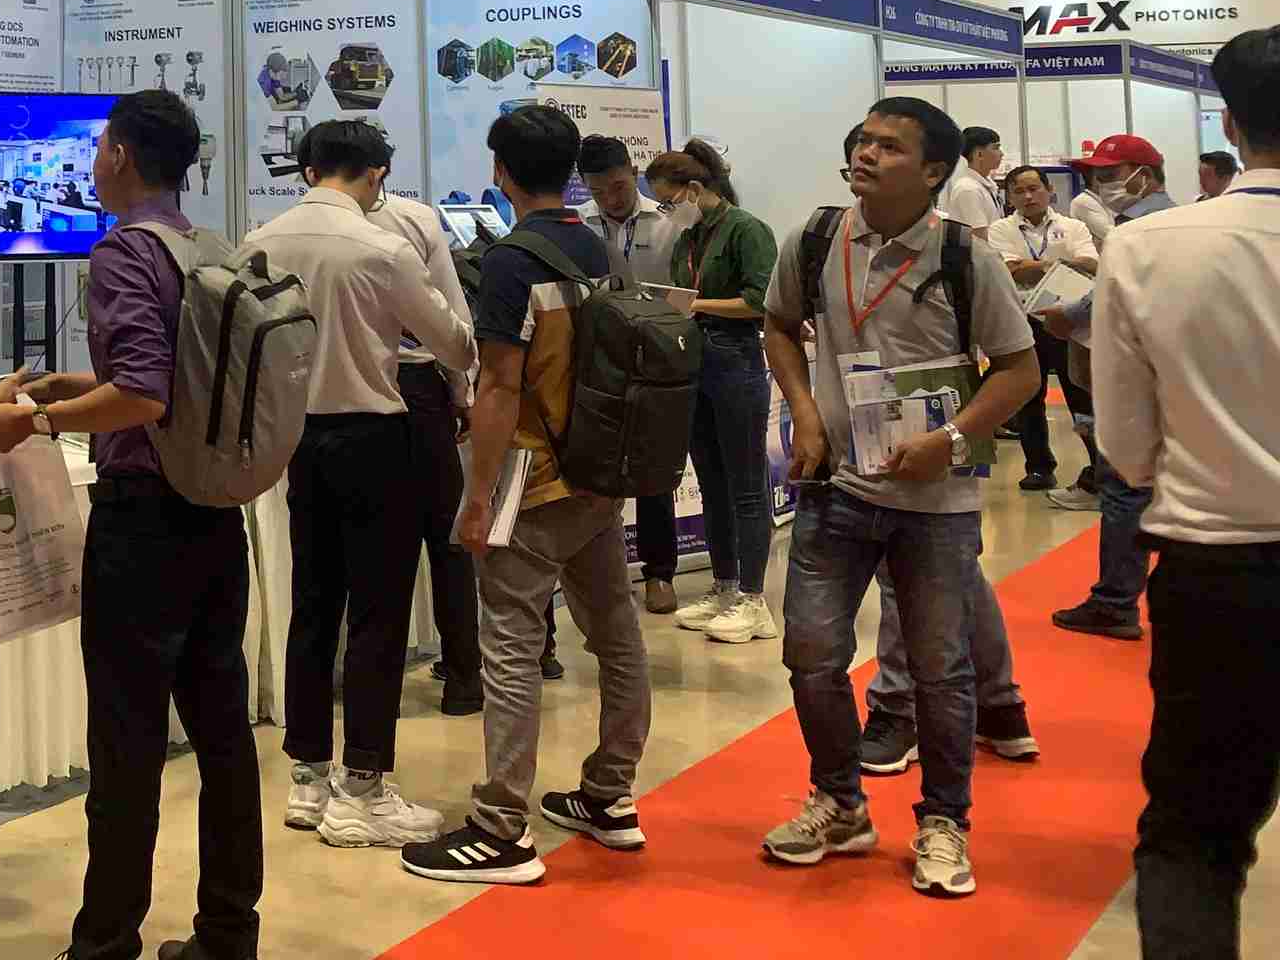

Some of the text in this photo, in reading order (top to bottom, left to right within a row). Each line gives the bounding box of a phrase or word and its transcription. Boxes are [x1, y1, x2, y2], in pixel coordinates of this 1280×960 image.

[485, 4, 583, 23] COUPLINGS
[1008, 0, 1131, 35] MAX
[1135, 7, 1238, 23] PHOTONICS
[104, 26, 183, 42] INSTRUMENT
[253, 14, 397, 35] WEIGHING SYSTEMS
[1044, 57, 1072, 69] VIỆT
[1074, 56, 1105, 67] NAM
